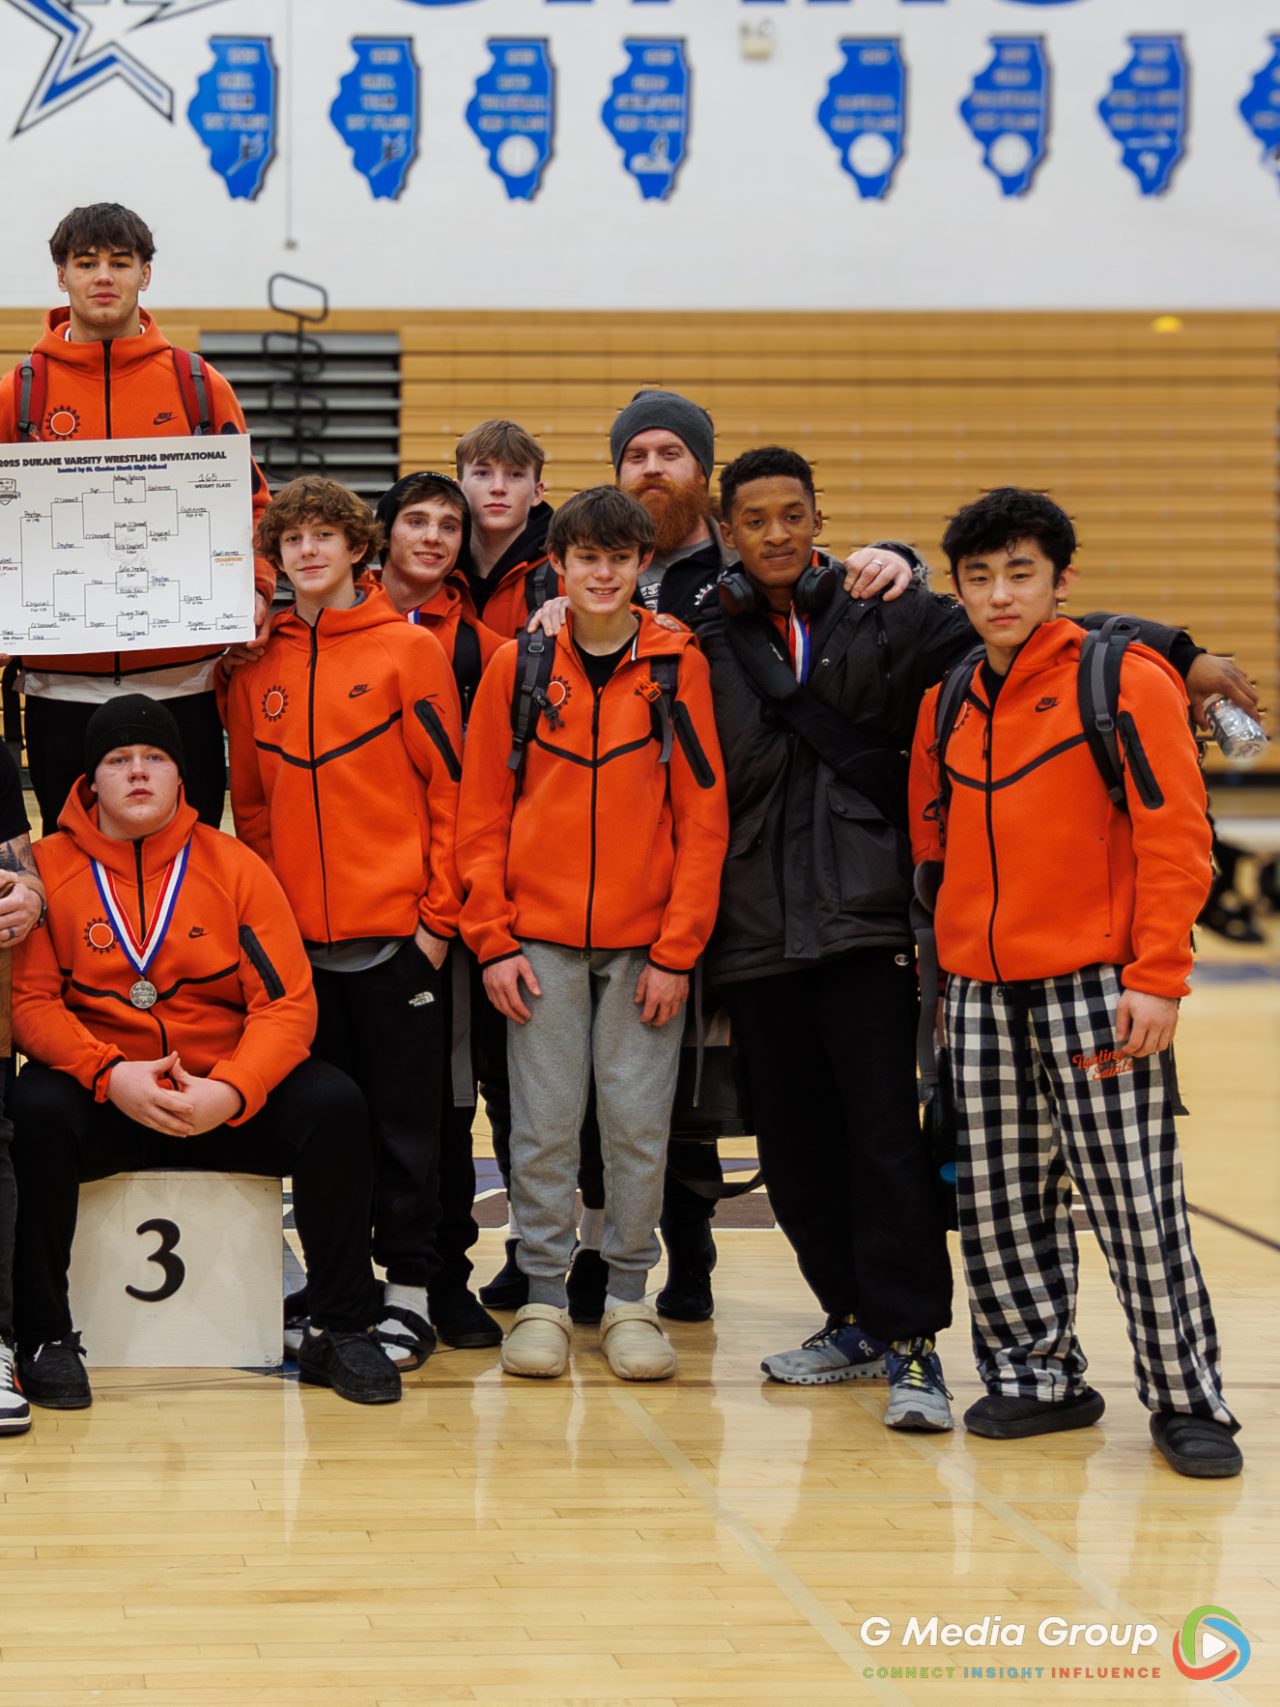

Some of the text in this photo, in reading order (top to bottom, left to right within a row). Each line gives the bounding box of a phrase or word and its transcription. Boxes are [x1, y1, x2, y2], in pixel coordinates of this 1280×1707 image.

[23, 458, 62, 466] DUKANE
[64, 456, 102, 465] VARSITY
[104, 454, 157, 464] WRESTLING
[160, 451, 226, 461] INVITATIONAL
[125, 1218, 186, 1302] 3
